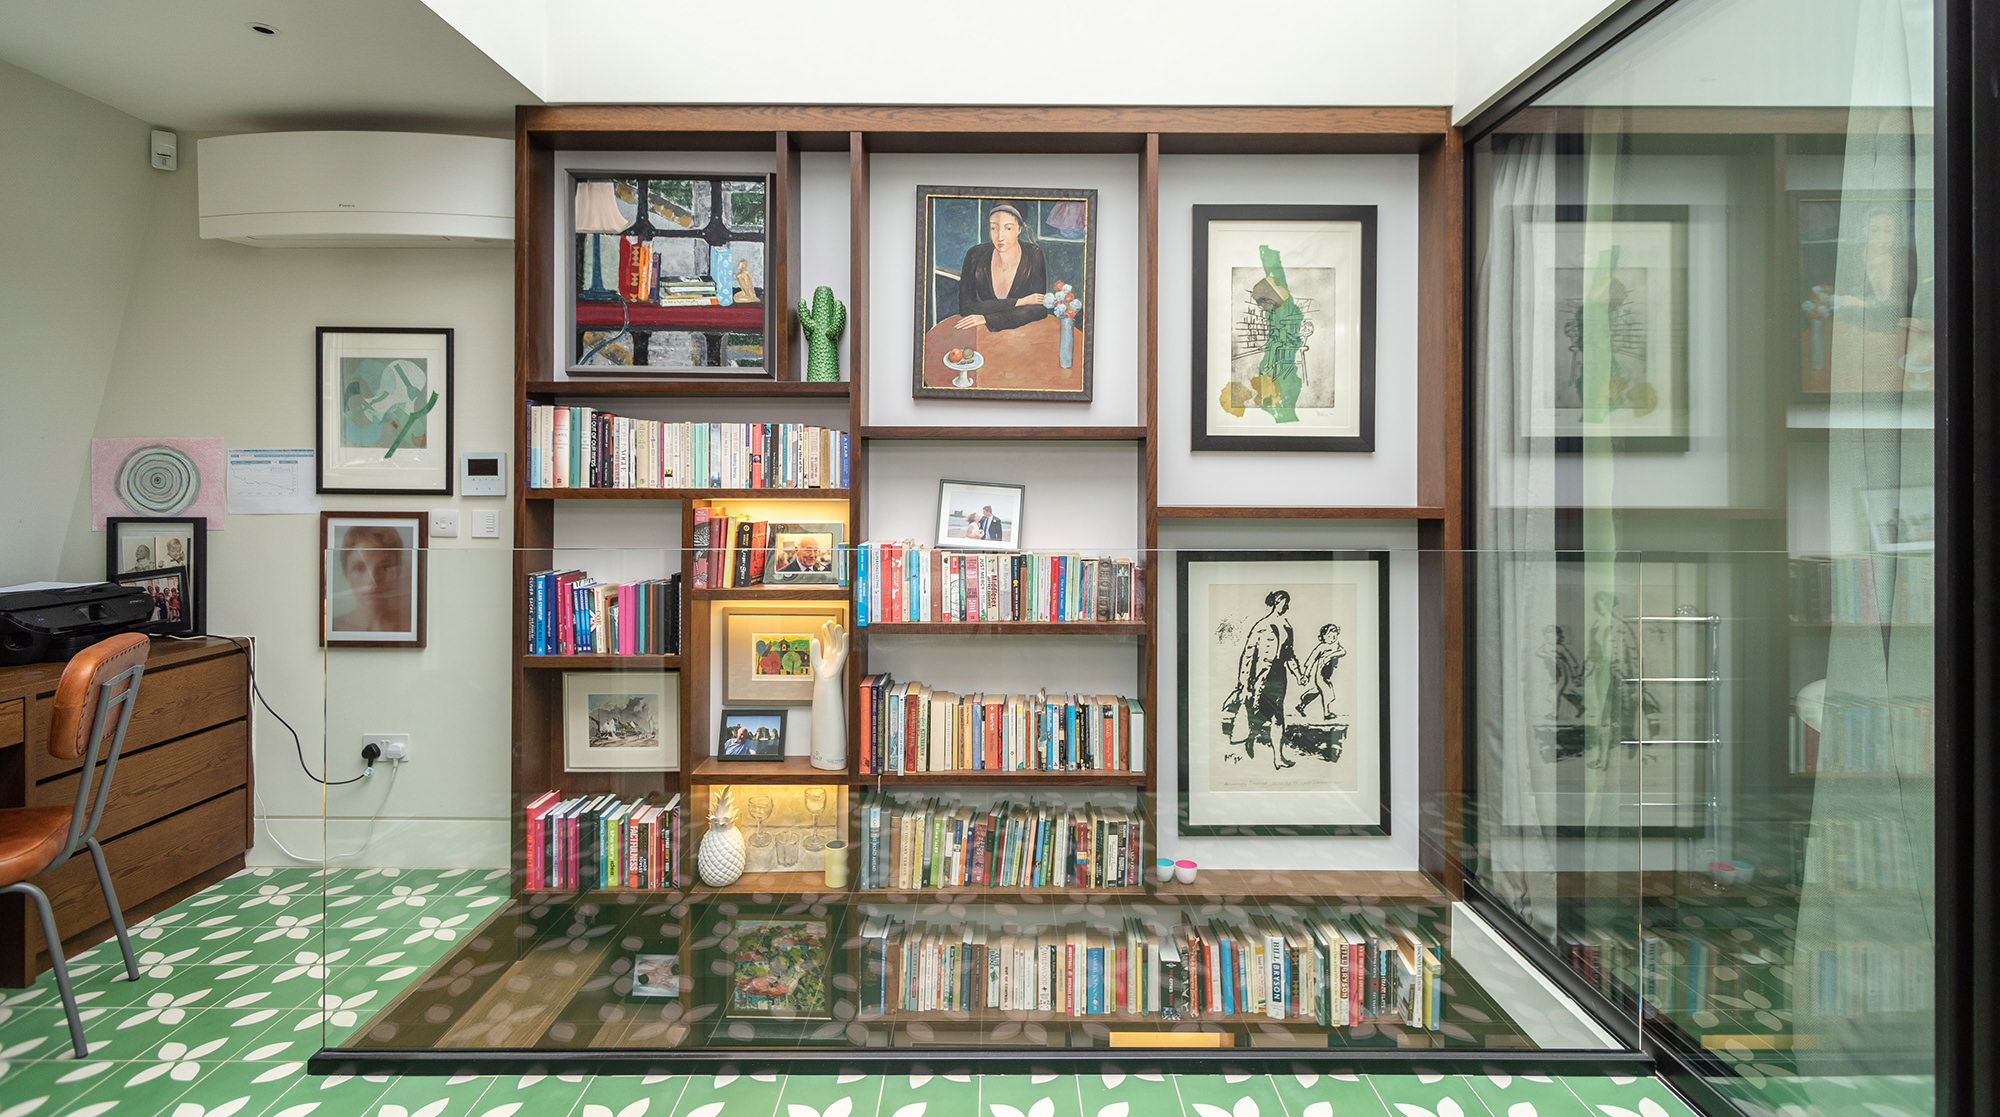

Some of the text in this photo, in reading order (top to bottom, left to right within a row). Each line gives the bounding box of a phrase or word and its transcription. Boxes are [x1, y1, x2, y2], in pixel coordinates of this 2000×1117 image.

[990, 575, 998, 608] Middlesex
[629, 825, 639, 871] FACTFULNESS
[1272, 941, 1281, 1000] BILL BRYSON
[1340, 945, 1349, 999] BILL BRYSON
